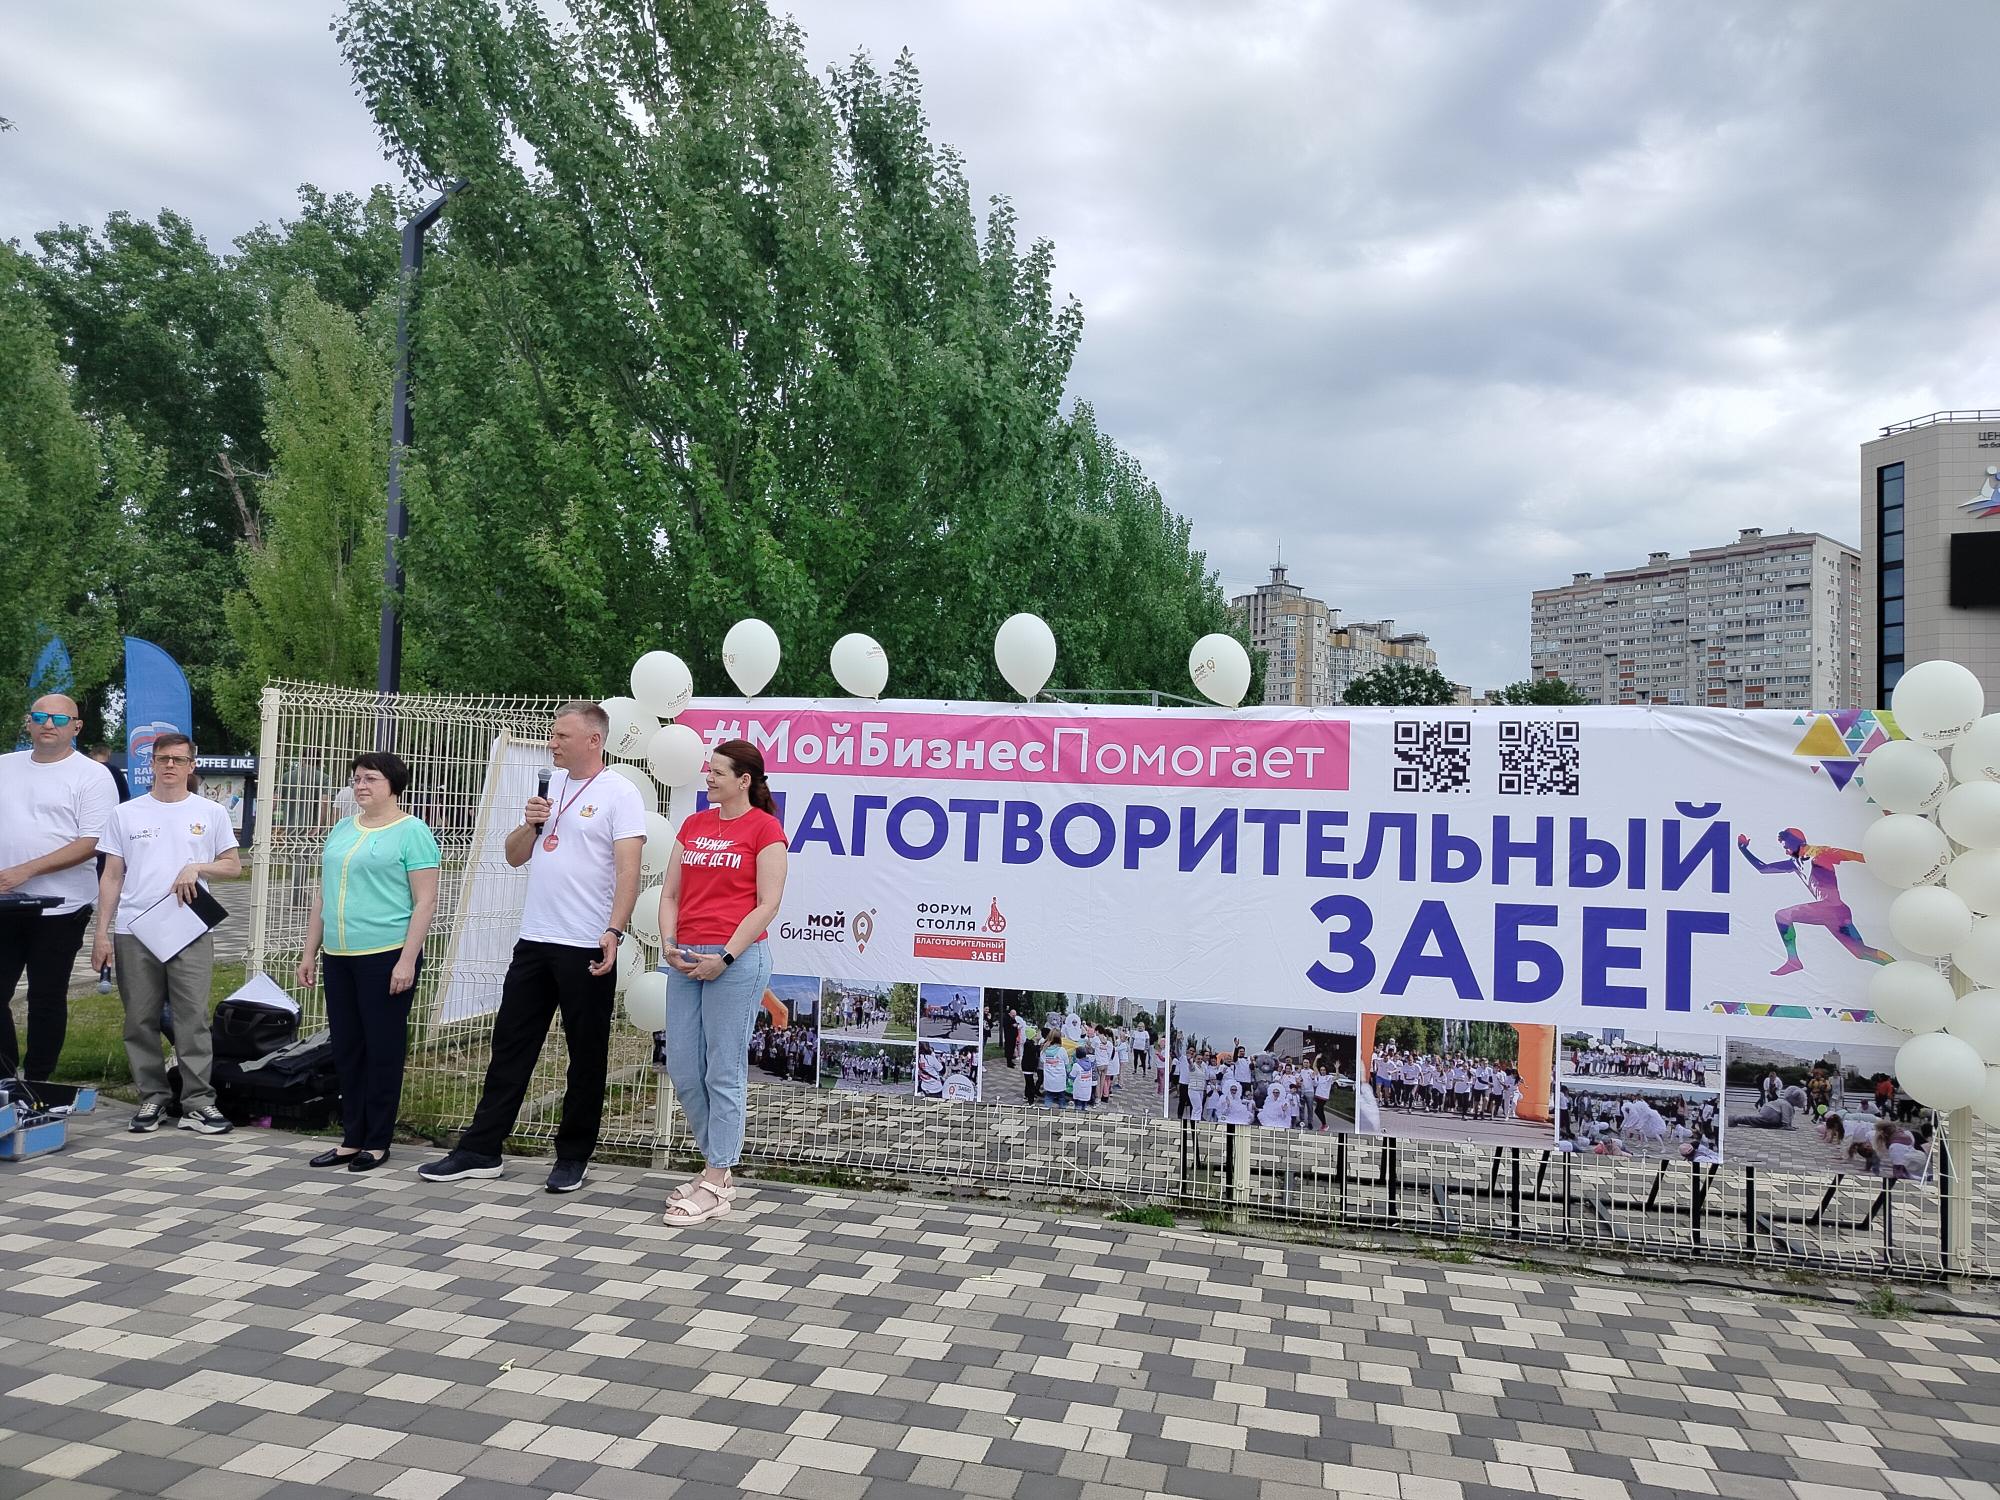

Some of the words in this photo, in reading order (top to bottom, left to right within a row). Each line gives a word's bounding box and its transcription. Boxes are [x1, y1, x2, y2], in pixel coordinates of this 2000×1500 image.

[195, 758, 229, 768] OFFEE
[230, 758, 255, 768] LIKE
[696, 791, 1730, 893] АГОТВОРИТЕЛЬНЫЙ
[708, 852, 742, 869] ДЕТИ
[916, 902, 972, 916] ФОРУМ
[807, 910, 846, 928] мой
[916, 918, 976, 931] СТОЛЛЯ
[780, 921, 845, 943] бизнес
[916, 937, 1004, 949] БЛАГОТВОРИТЕЛЬНЫЙ
[971, 951, 1004, 962] ЗАБЕГ
[1307, 894, 1729, 1011] ЗАБЕГ
